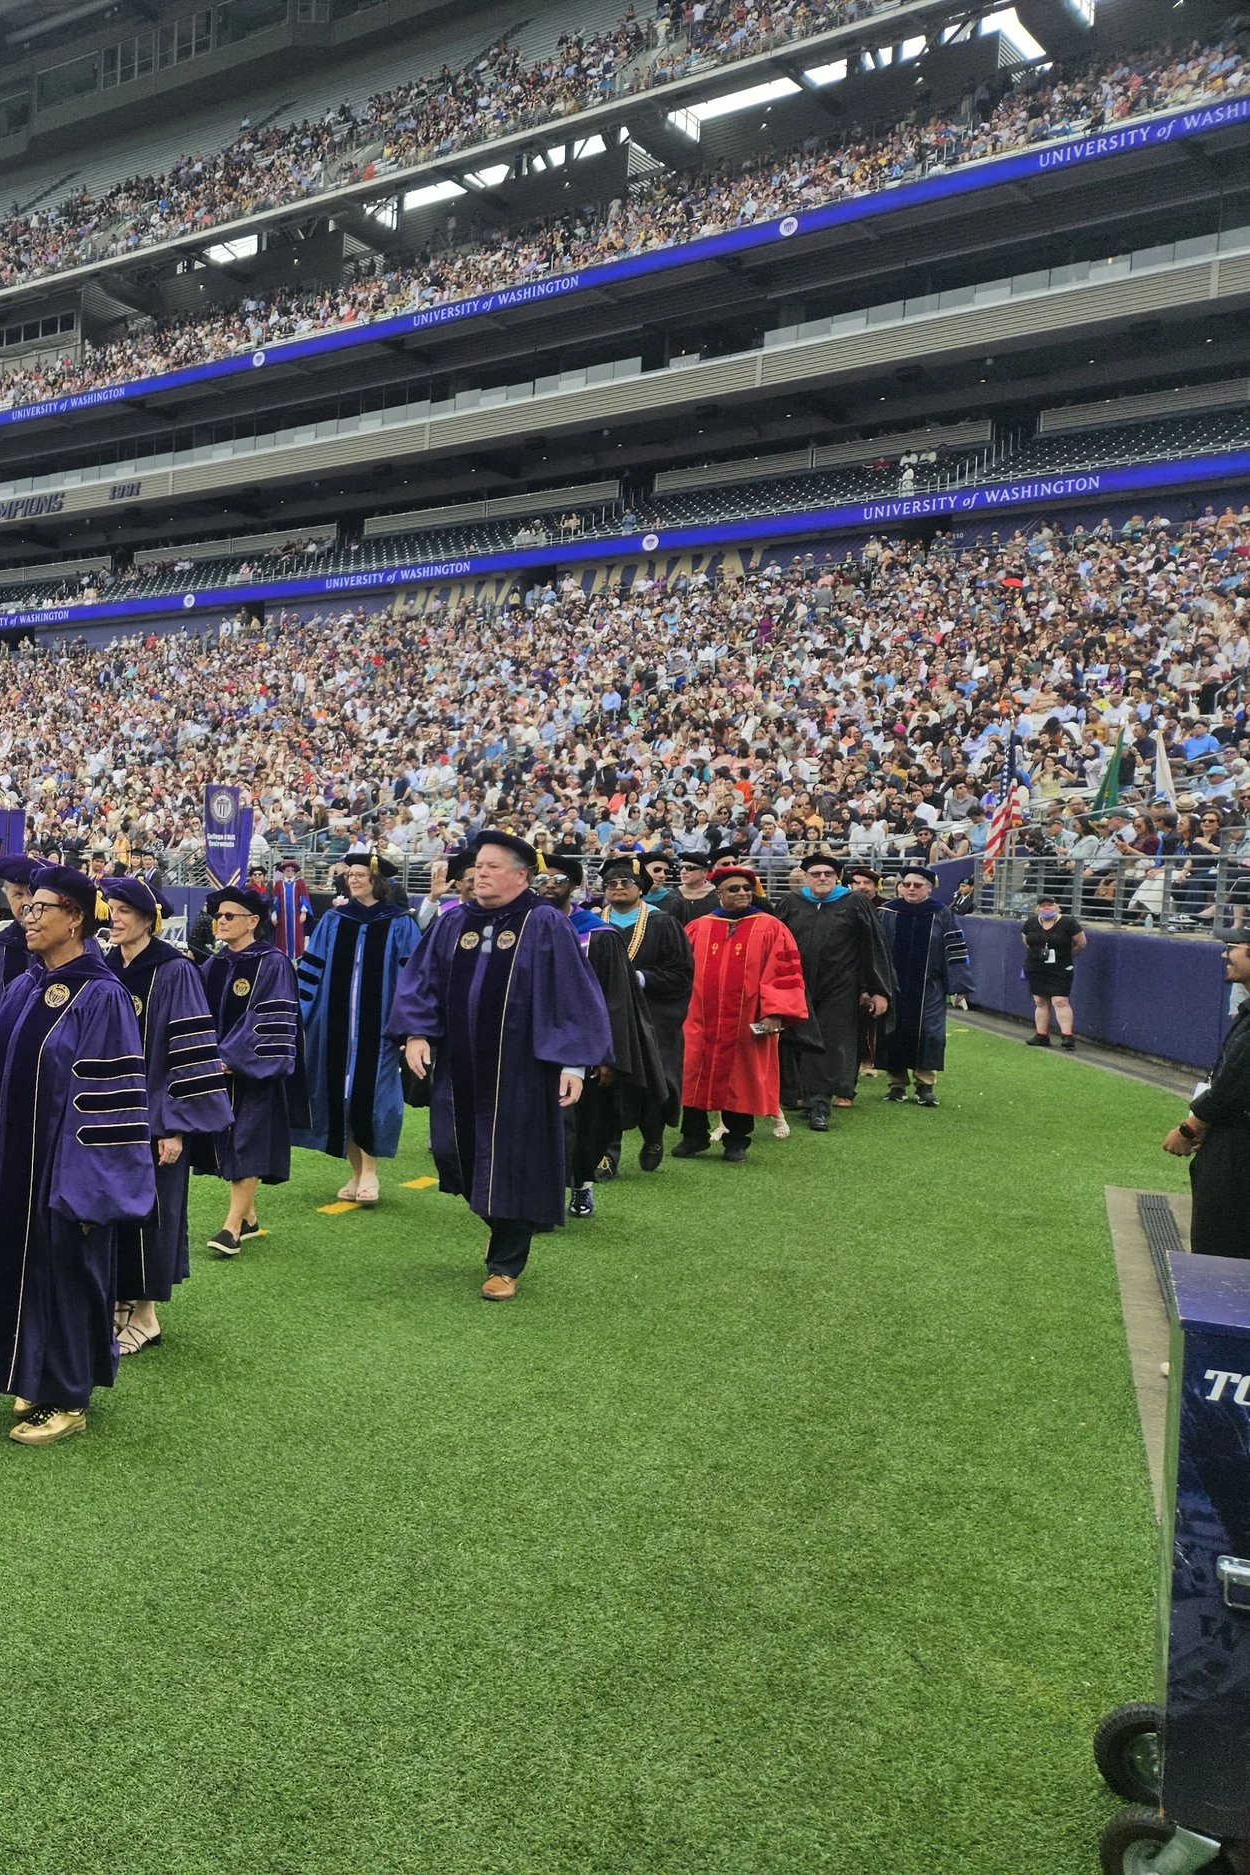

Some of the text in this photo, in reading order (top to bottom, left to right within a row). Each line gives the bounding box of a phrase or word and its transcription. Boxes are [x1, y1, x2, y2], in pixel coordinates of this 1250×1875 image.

[1039, 126, 1150, 168] UNIVERSITY
[1157, 119, 1176, 140] of
[413, 275, 579, 327] UNIVERSITY of WASHINGTON
[11, 387, 125, 420] UNIVERSITY of WASHINGTON
[863, 475, 1100, 520] UNIVERSITY of WASHINGTON
[325, 560, 471, 590] UNIVERSITY of WASHINGTON
[9, 615, 17, 627] of
[19, 608, 69, 625] WASHINGTON
